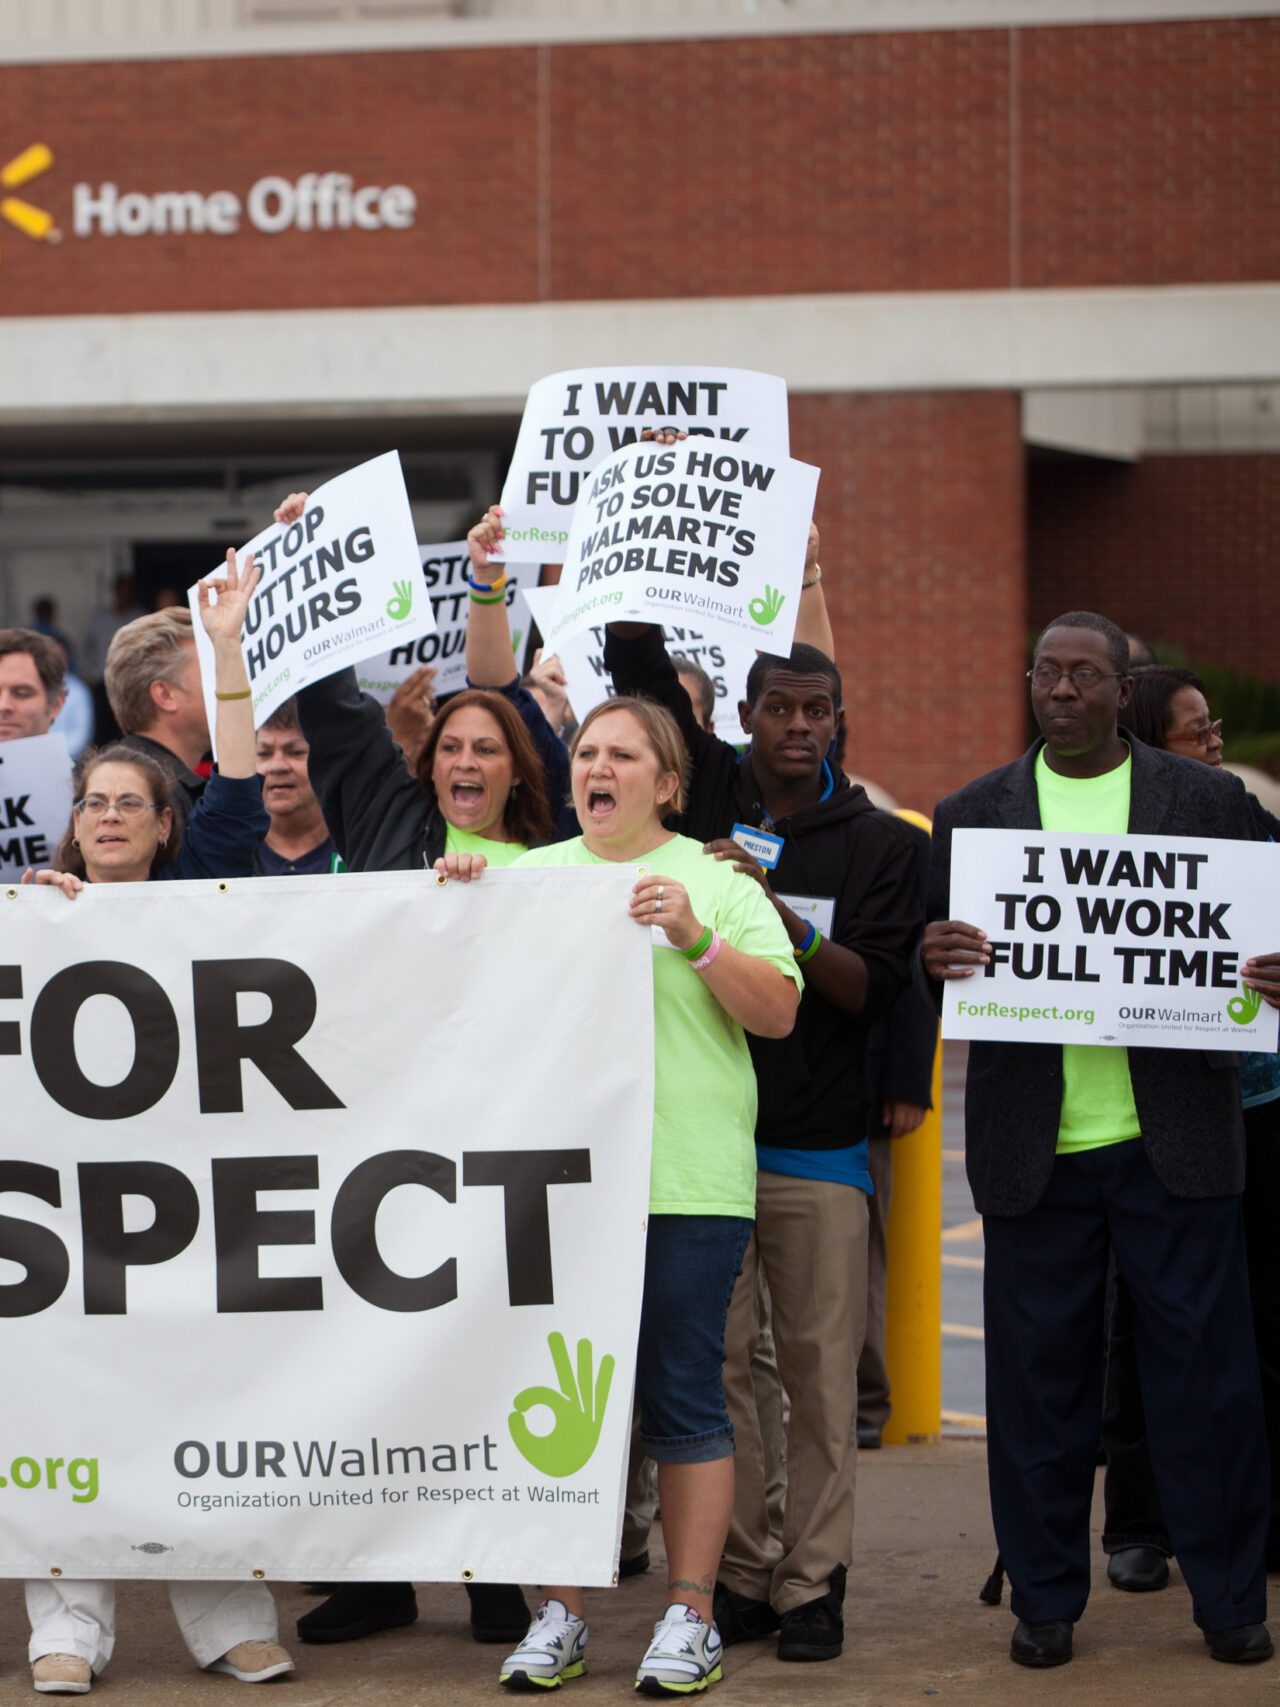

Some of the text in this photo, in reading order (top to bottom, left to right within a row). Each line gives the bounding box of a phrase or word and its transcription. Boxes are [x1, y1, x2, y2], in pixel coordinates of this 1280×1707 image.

[73, 182, 240, 237] Home
[247, 172, 417, 233] Office
[563, 381, 727, 417] I WANT
[540, 426, 594, 461] TO
[526, 471, 587, 506] FU
[588, 451, 775, 505] ASK US HOW
[596, 482, 742, 524] TO SOLVE
[579, 515, 755, 563] WALMART'S
[241, 526, 375, 644] UTTING
[423, 555, 470, 588] ST
[576, 547, 740, 593] PROBLEMS
[247, 578, 362, 680] HOURS
[389, 628, 467, 665] HOU
[743, 839, 772, 856] PRESTON
[1022, 846, 1208, 890] I WANT
[995, 893, 1232, 940] TO WORK
[984, 941, 1239, 988] FULL TIME
[957, 1001, 1095, 1024] ForRespect.org
[1118, 1022, 1160, 1030] Organization
[1161, 1023, 1182, 1031] United
[1183, 1024, 1194, 1032] for
[1195, 1025, 1221, 1033] Respect
[1230, 1026, 1257, 1034] Walmart
[177, 1485, 600, 1511] Organization United for Respect at Walmart
